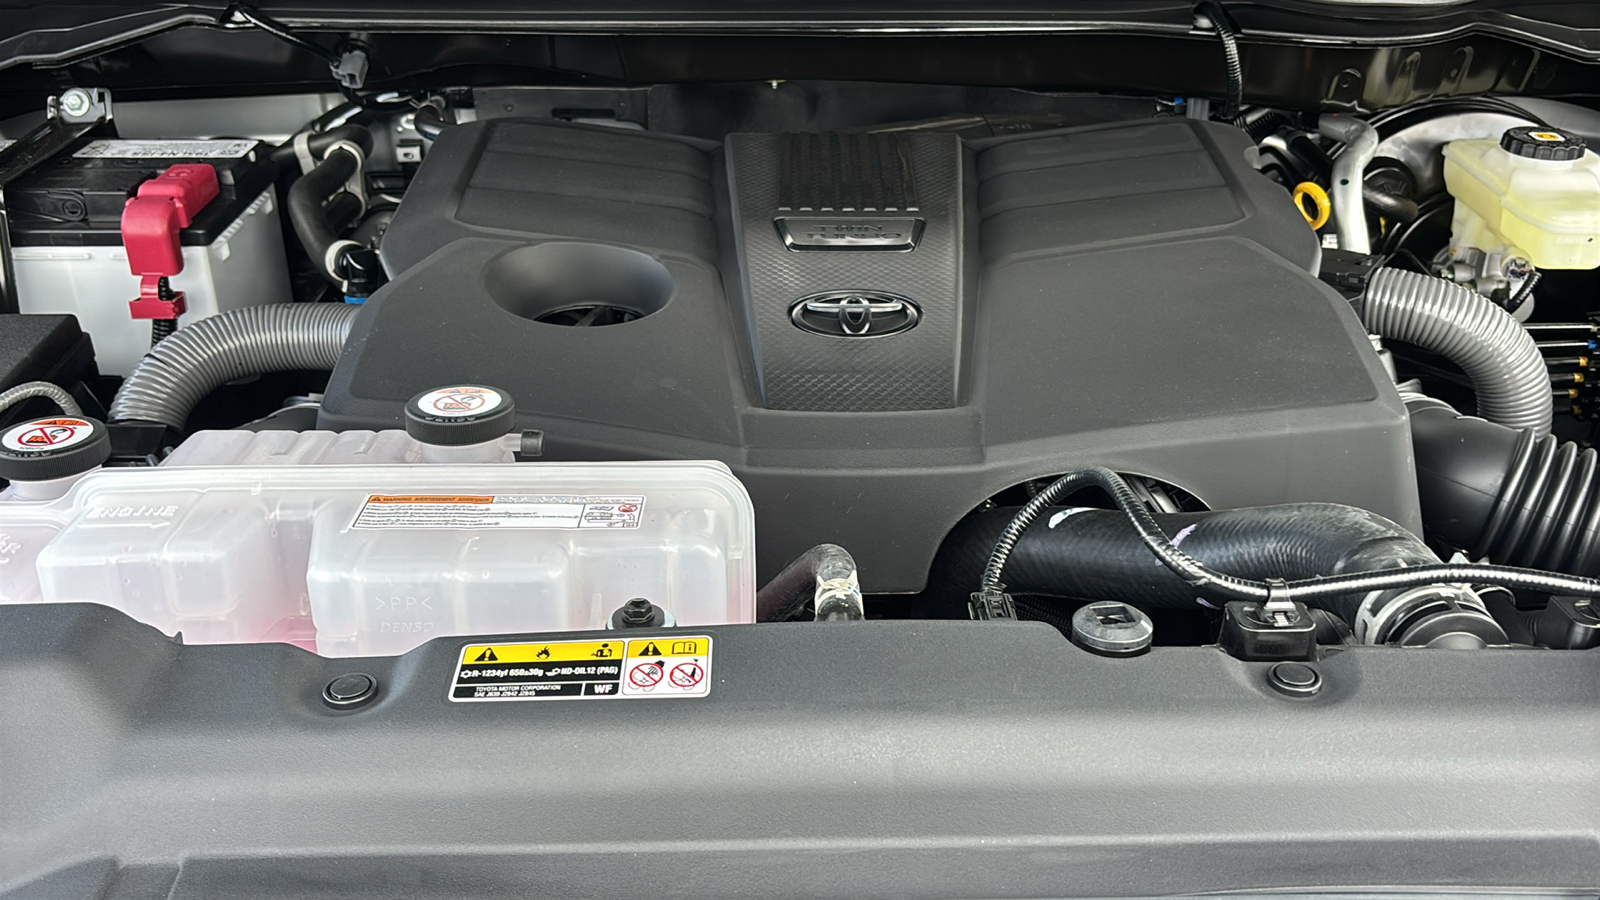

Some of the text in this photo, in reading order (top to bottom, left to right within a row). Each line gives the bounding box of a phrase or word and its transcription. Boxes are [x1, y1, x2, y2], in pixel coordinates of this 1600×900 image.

[813, 224, 883, 232] TWIN
[86, 505, 179, 519] ENGINE
[380, 621, 434, 633] DENSO
[597, 666, 618, 675] (PAG)
[594, 684, 613, 694] WF
